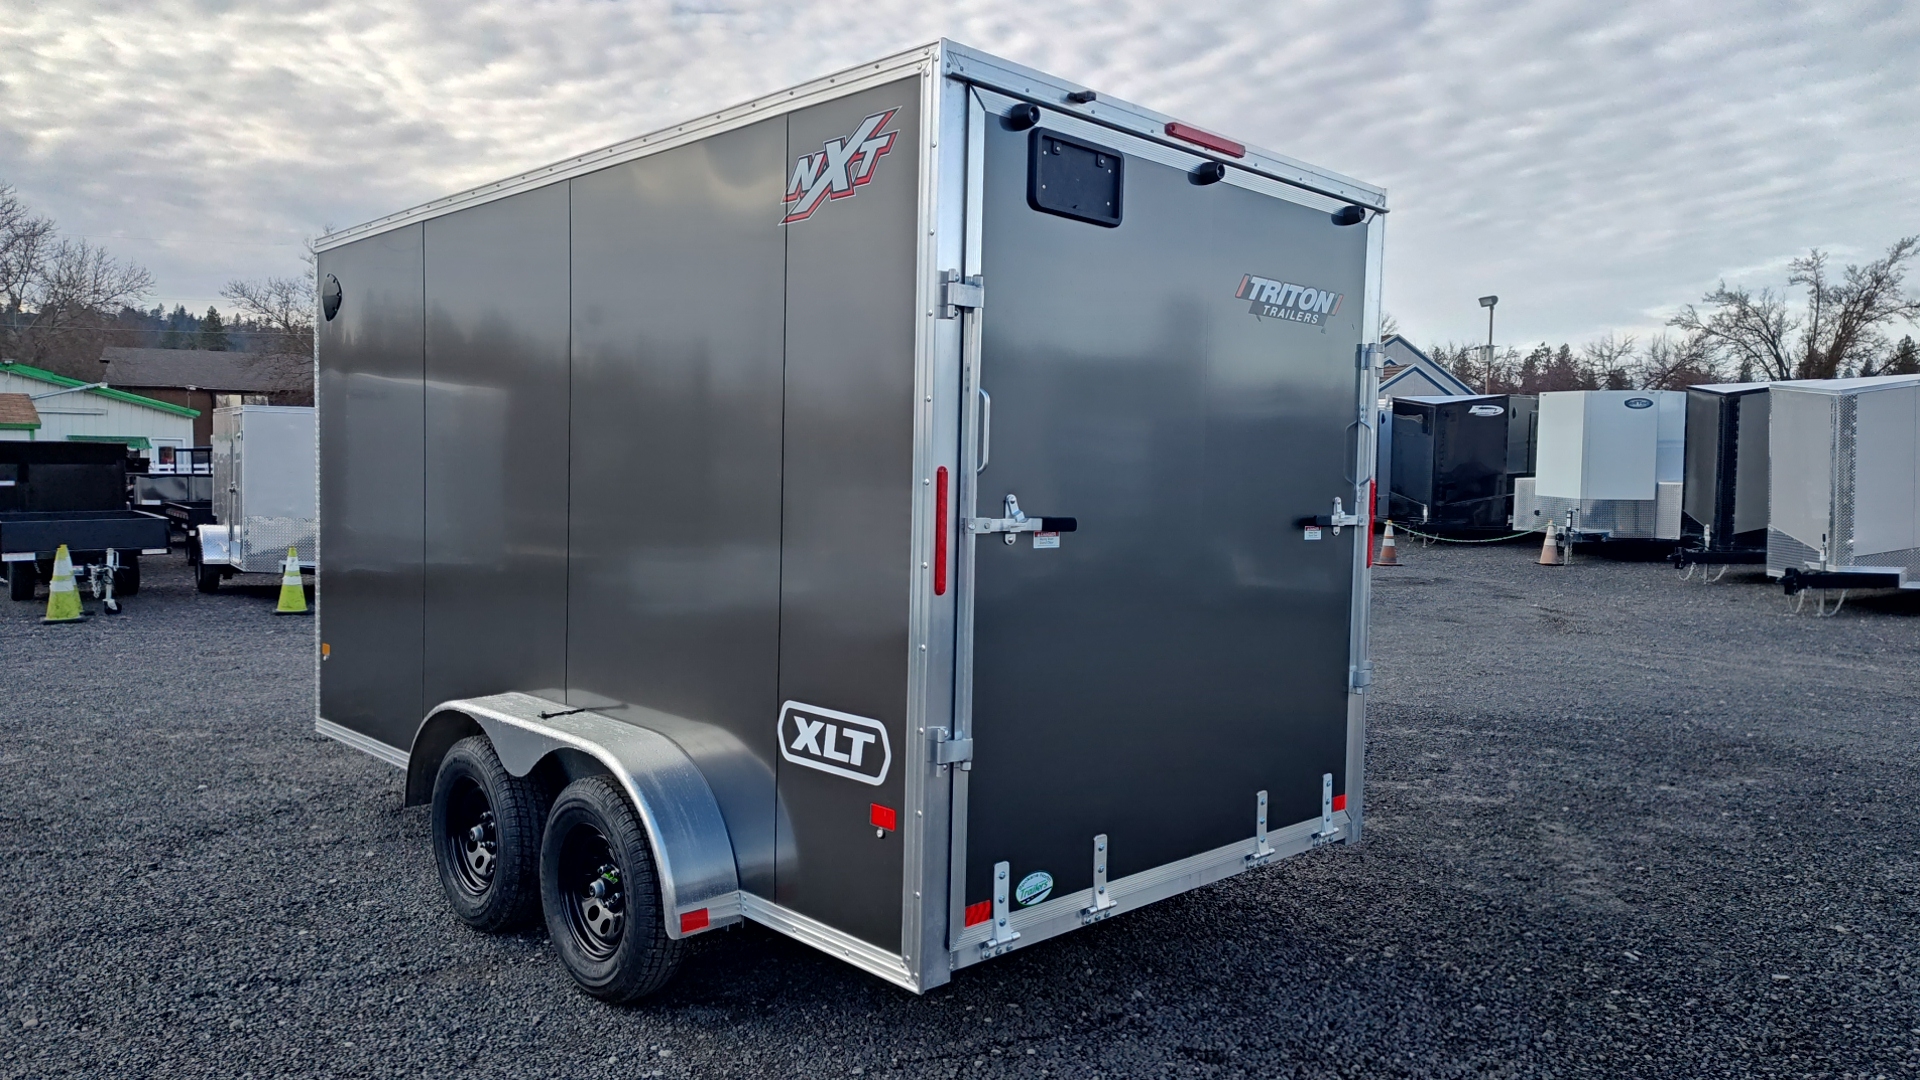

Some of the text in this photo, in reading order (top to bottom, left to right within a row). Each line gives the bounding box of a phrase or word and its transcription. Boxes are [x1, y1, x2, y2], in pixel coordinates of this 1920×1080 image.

[780, 107, 901, 224] NXT
[1249, 276, 1335, 314] TRITON
[1262, 305, 1319, 324] TRAILERS
[790, 715, 876, 767] XLT
[1020, 880, 1049, 899] Trailers
